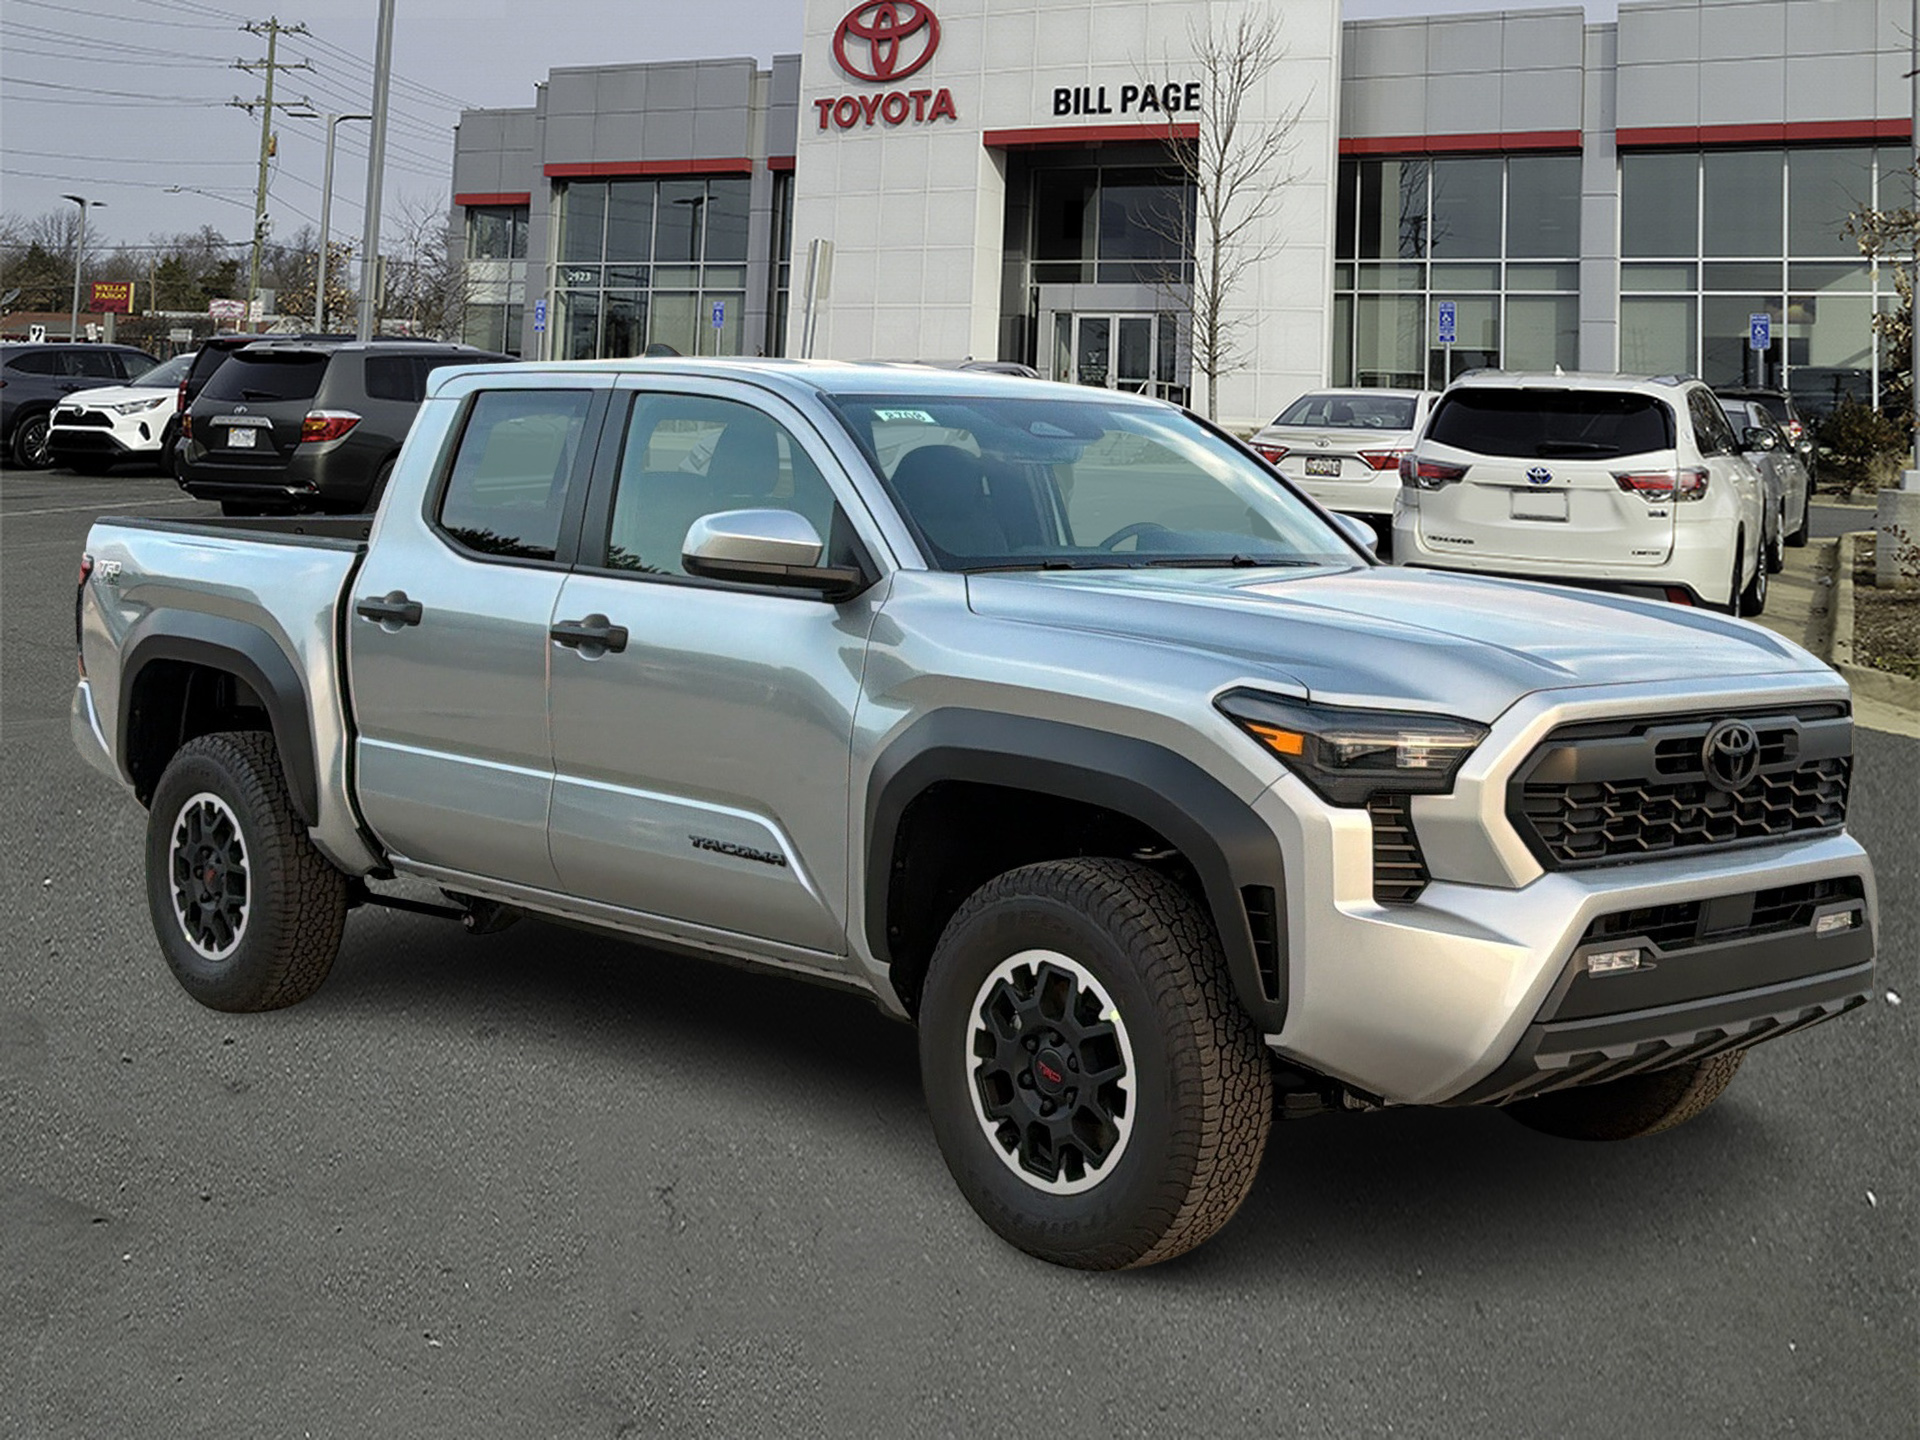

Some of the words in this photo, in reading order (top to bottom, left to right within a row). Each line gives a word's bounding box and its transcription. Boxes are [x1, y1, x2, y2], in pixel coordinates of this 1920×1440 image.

[814, 88, 958, 130] TOYOTA
[1053, 86, 1113, 116] BILL
[1121, 82, 1201, 114] PAGE
[568, 271, 591, 282] 2923
[95, 291, 127, 300] FARGO
[688, 834, 787, 868] TACOMA
[1037, 1060, 1062, 1083] TRD
